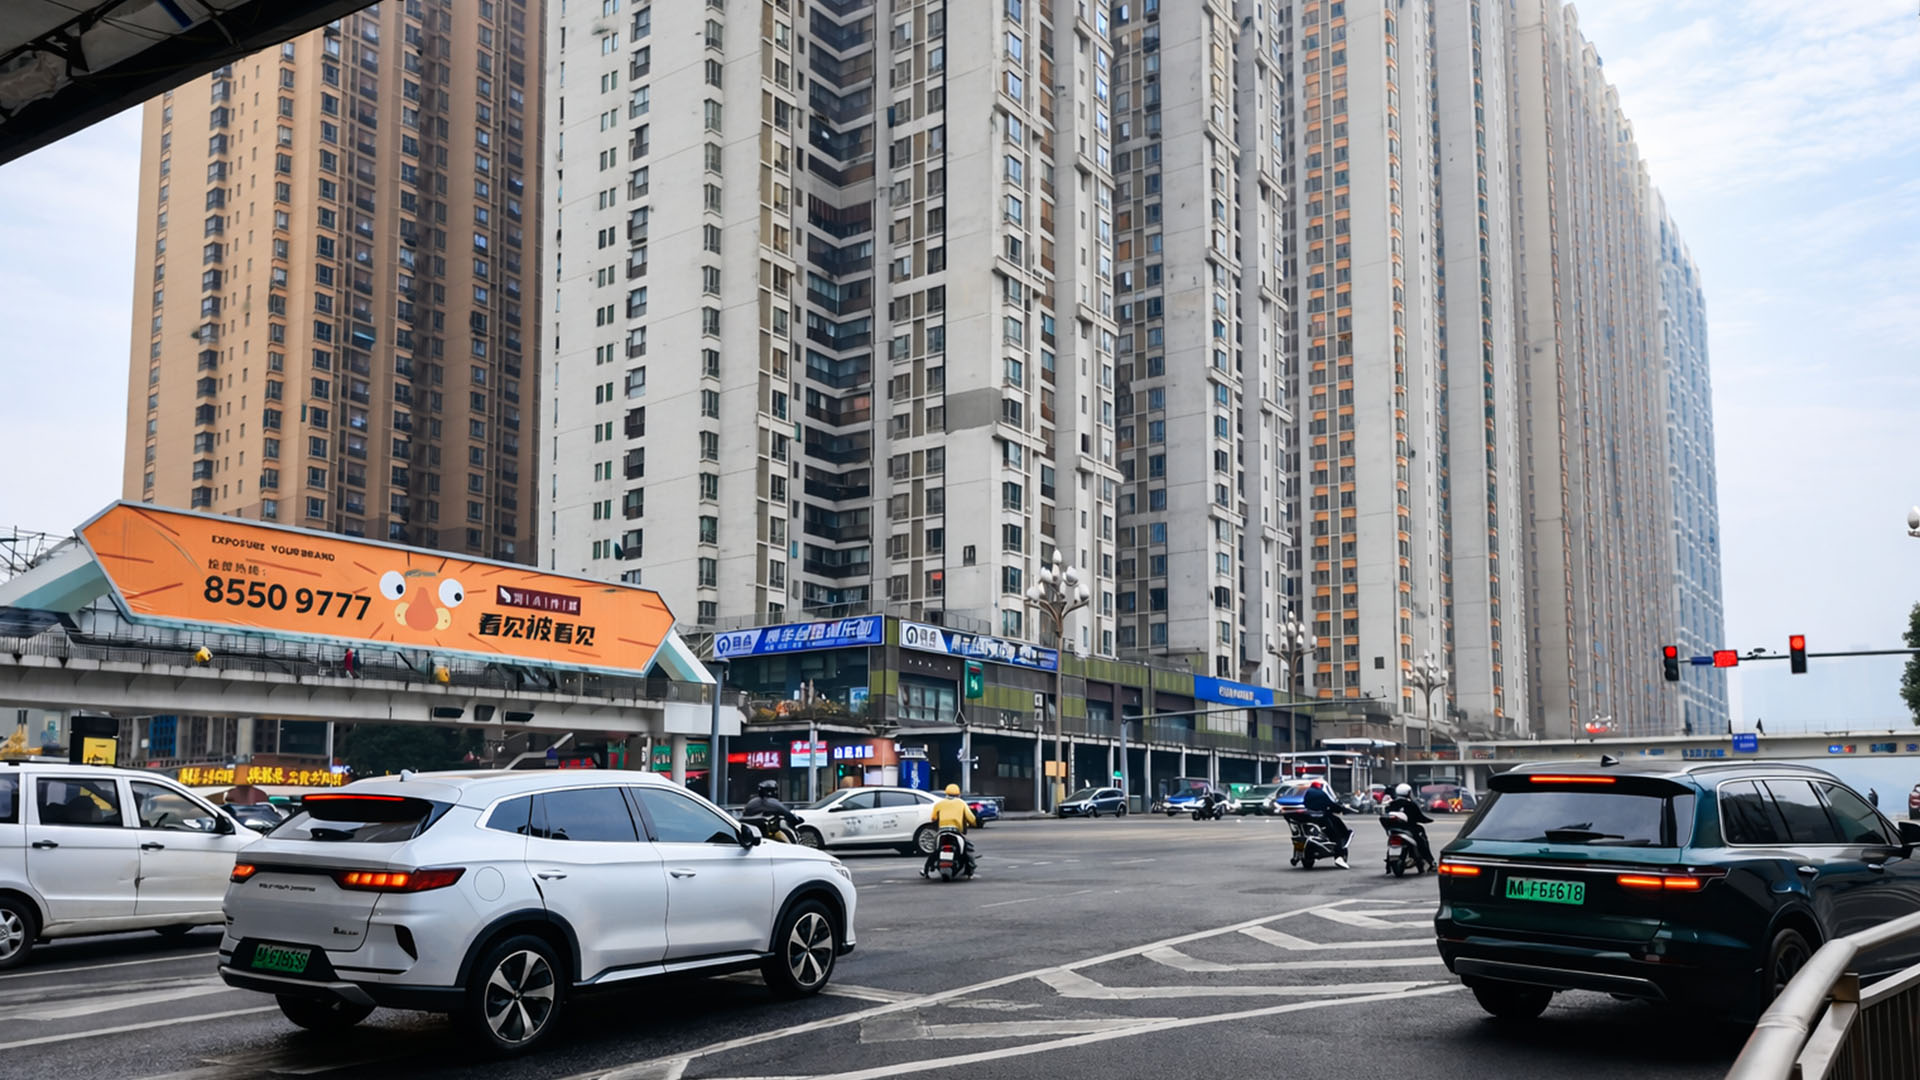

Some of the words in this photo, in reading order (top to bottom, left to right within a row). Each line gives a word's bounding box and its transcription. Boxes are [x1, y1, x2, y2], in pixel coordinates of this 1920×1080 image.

[211, 535, 265, 551] EXPOSURE
[271, 545, 299, 556] YOUR
[204, 575, 288, 611] 8550
[295, 587, 372, 621] 9777
[479, 612, 595, 646] 看见被看见
